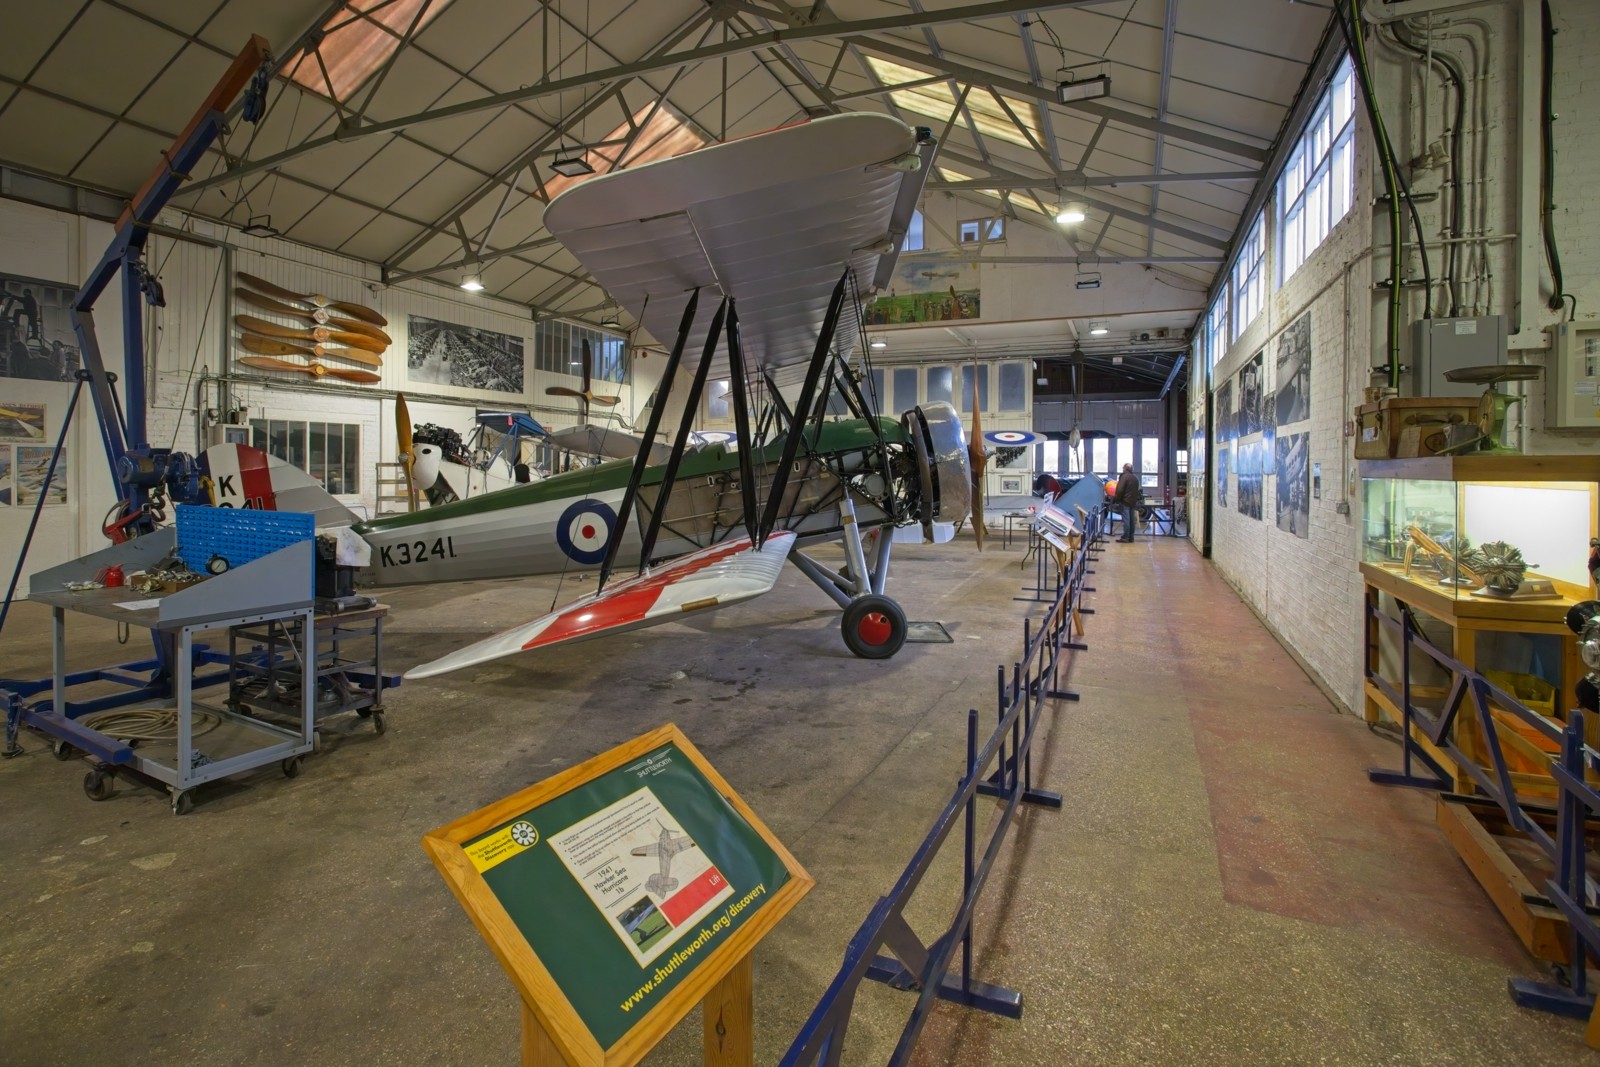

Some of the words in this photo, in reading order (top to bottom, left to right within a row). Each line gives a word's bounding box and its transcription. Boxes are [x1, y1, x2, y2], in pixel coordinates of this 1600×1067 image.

[218, 474, 237, 497] K
[636, 757, 672, 778] SHUTTLEWORTH
[484, 838, 513, 855] Shuttleworth
[485, 848, 507, 861] Discovery
[593, 874, 615, 890] Hawker
[615, 867, 626, 877] Sea
[598, 866, 613, 878] 1941
[709, 874, 721, 887] Lift
[601, 875, 629, 895] Hurricane
[615, 886, 625, 894] 1b
[620, 883, 766, 1012] www.shuttleworth.org/discovery
